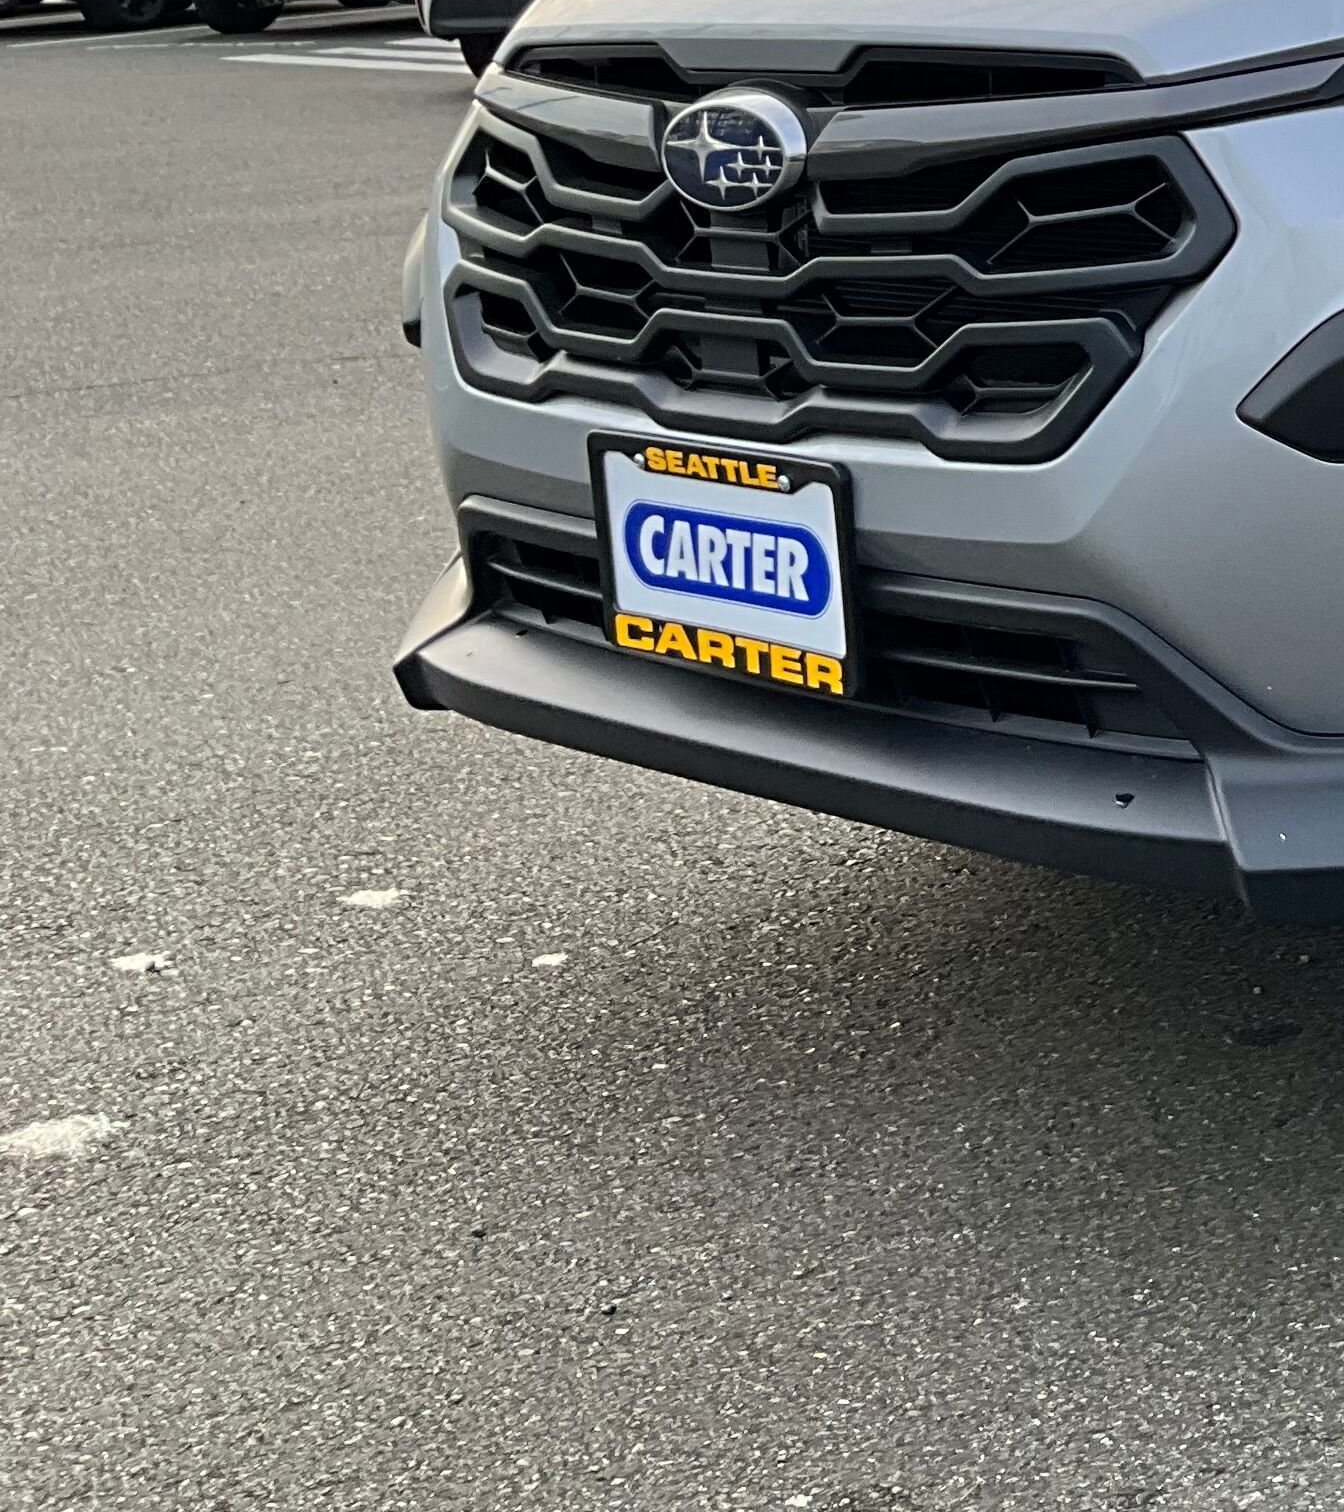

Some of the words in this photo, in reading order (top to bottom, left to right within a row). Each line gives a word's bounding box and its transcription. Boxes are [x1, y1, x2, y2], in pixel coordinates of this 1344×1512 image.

[645, 446, 779, 489] SEATTLE
[639, 514, 809, 602] CARTER
[615, 613, 844, 695] CARTER
